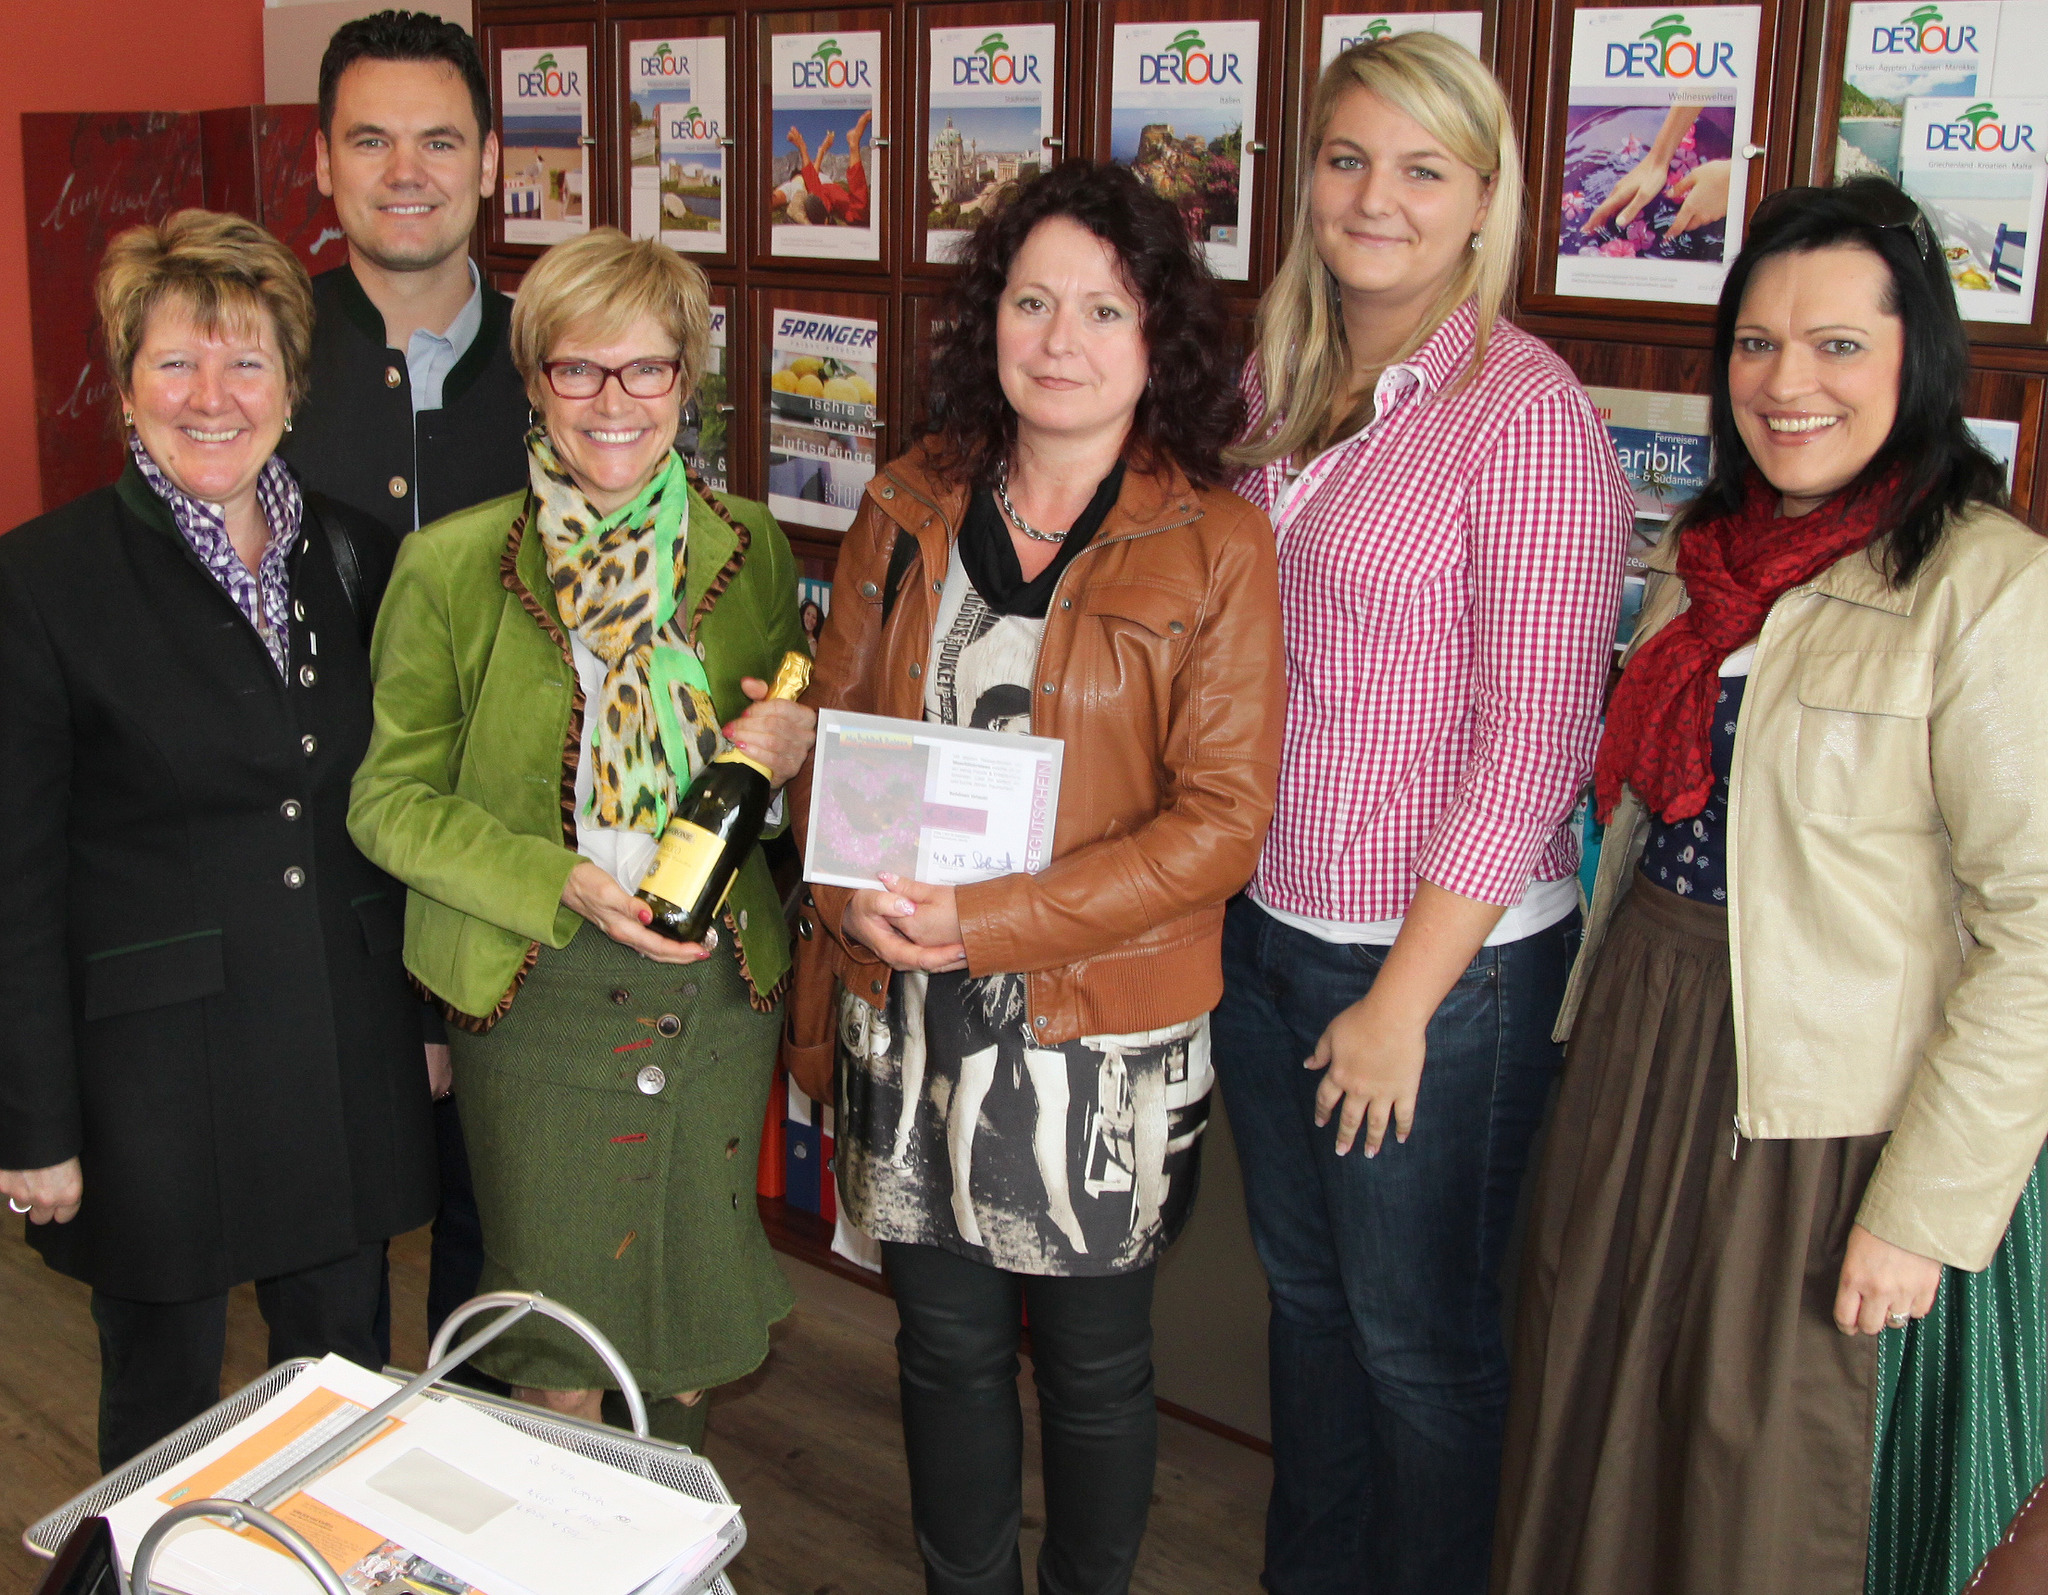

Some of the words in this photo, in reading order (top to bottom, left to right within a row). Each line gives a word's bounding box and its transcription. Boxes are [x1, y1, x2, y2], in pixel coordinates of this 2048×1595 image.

[1605, 21, 1738, 78] DERTOUR
[1872, 10, 1979, 54] DERTOUR
[518, 57, 581, 96] DERTOUR
[641, 45, 690, 76] DERTOUR
[793, 44, 872, 88] DERTOUR
[953, 38, 1042, 85] DERTOUR
[1140, 35, 1243, 85] DERTOUR
[1668, 92, 1734, 102] Wellnesswelten
[671, 109, 720, 139] DERTOUR
[1926, 107, 2036, 152] DERTOUR
[777, 318, 878, 349] SPRINGER
[1612, 438, 1692, 475] aribik
[1655, 432, 1698, 446] Fernreisen
[1653, 472, 1704, 487] Südamerik
[1625, 557, 1649, 569] zea
[1026, 760, 1052, 876] SEGUTSCHEIN
